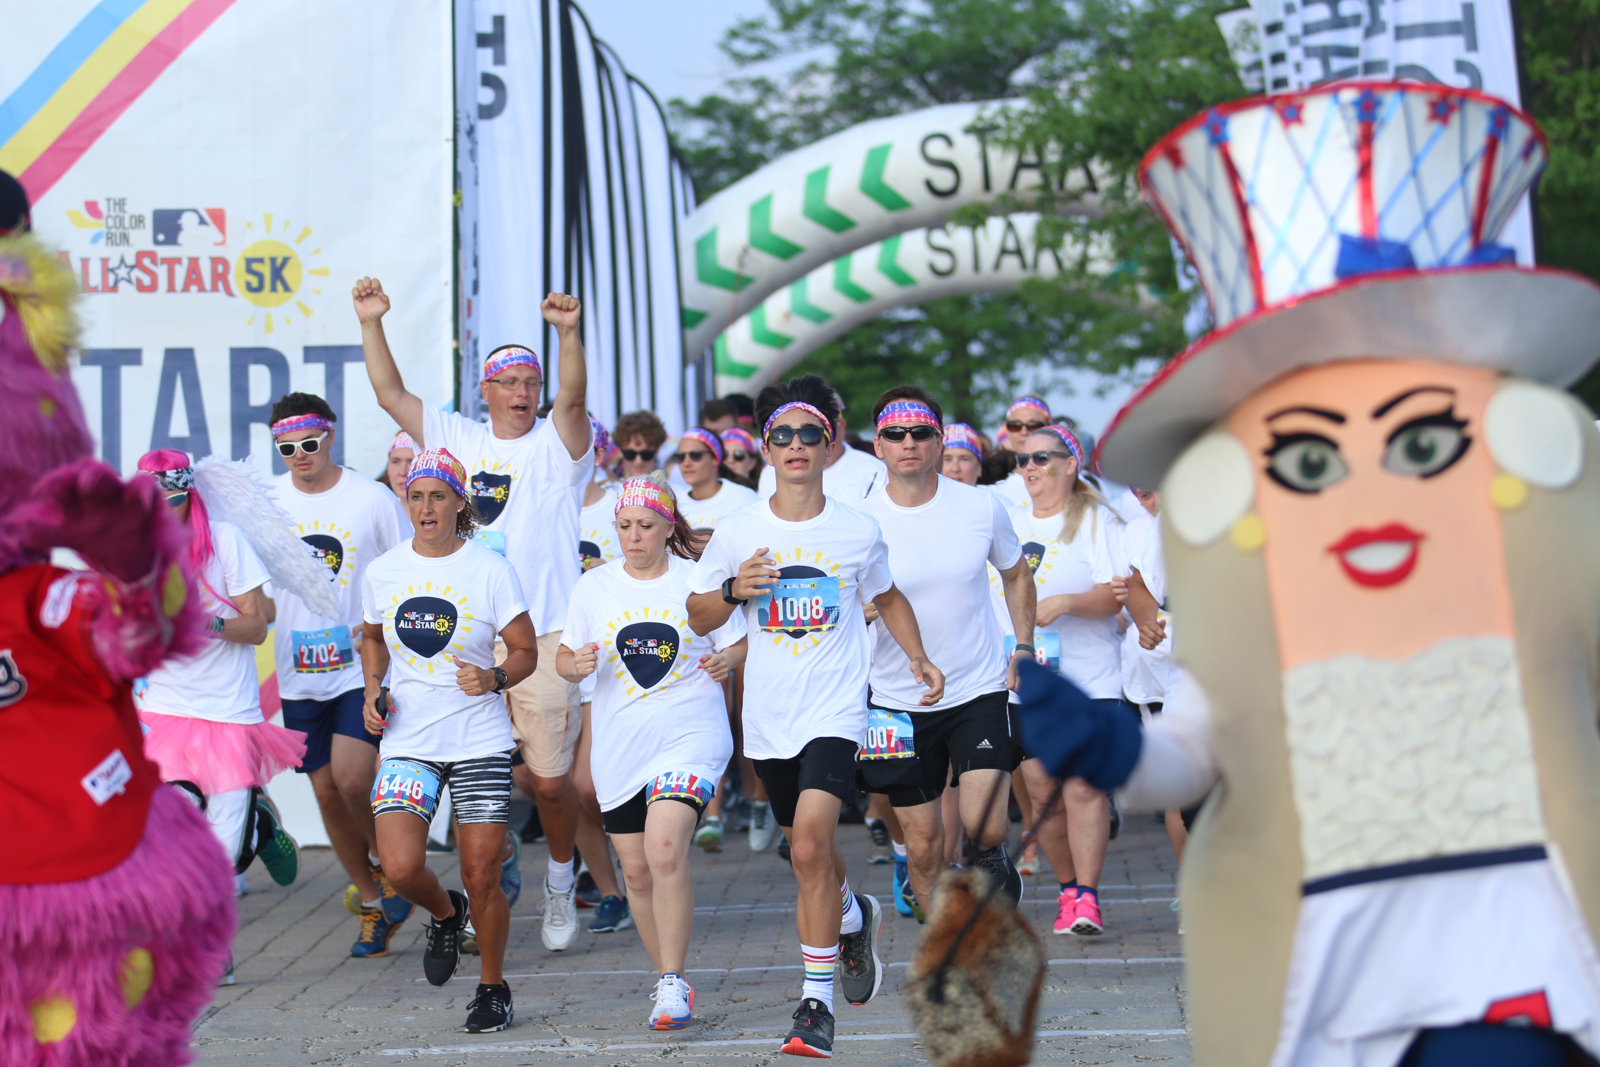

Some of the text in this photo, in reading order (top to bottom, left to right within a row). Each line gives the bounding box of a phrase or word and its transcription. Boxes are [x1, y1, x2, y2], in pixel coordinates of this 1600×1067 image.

[920, 124, 1098, 197] STAR
[105, 197, 129, 213] THE
[105, 214, 146, 230] COLOR
[244, 256, 293, 294] 5K
[80, 344, 366, 478] TART
[416, 460, 438, 471] RUN
[628, 478, 646, 487] THE
[623, 496, 645, 507] RUN
[625, 486, 659, 501] COLOR
[776, 596, 824, 621] 1008
[436, 621, 447, 629] 5K
[300, 642, 340, 664] 2702
[659, 647, 669, 656] 5K
[379, 774, 424, 800] 5446
